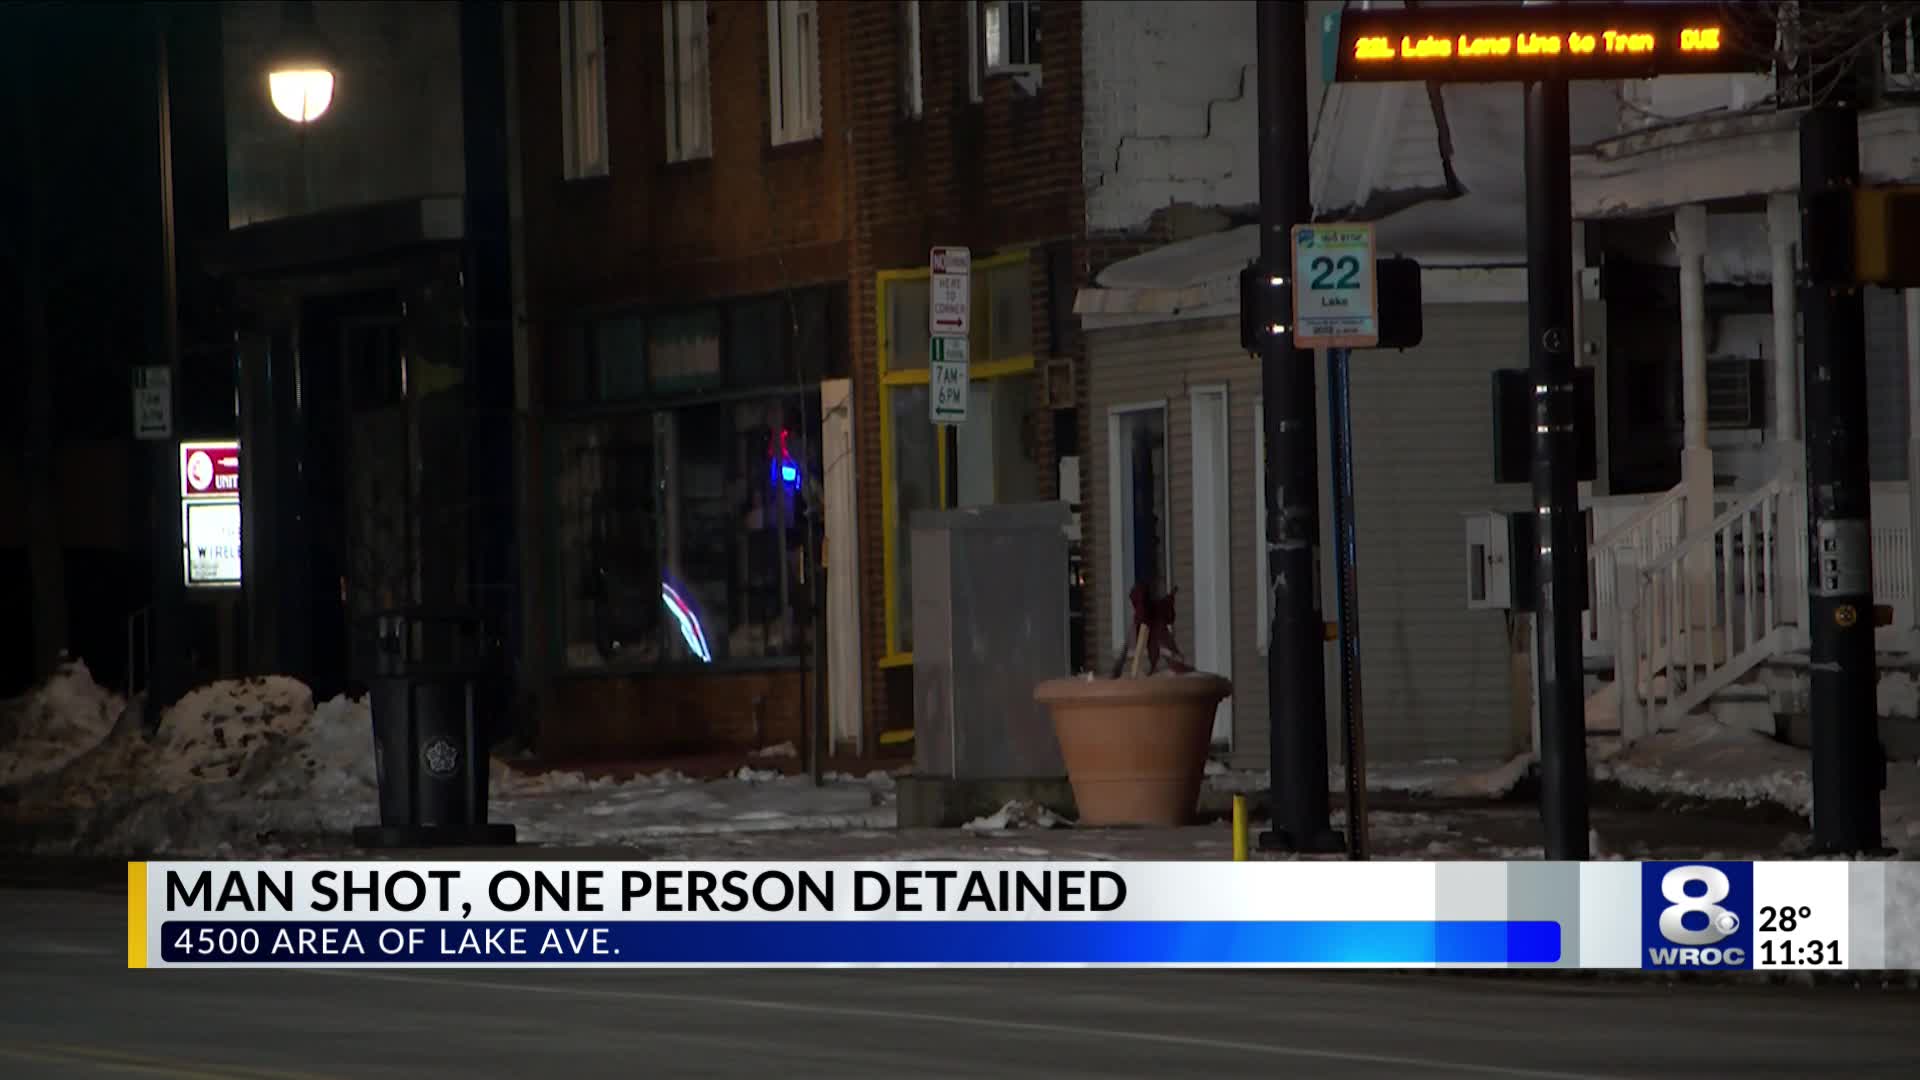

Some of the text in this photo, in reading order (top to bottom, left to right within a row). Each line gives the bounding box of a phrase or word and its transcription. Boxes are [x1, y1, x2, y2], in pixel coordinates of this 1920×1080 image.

[1567, 31, 1596, 54] to
[1310, 255, 1361, 290] 22
[1321, 295, 1348, 307] Lake
[938, 385, 961, 403] 6PM
